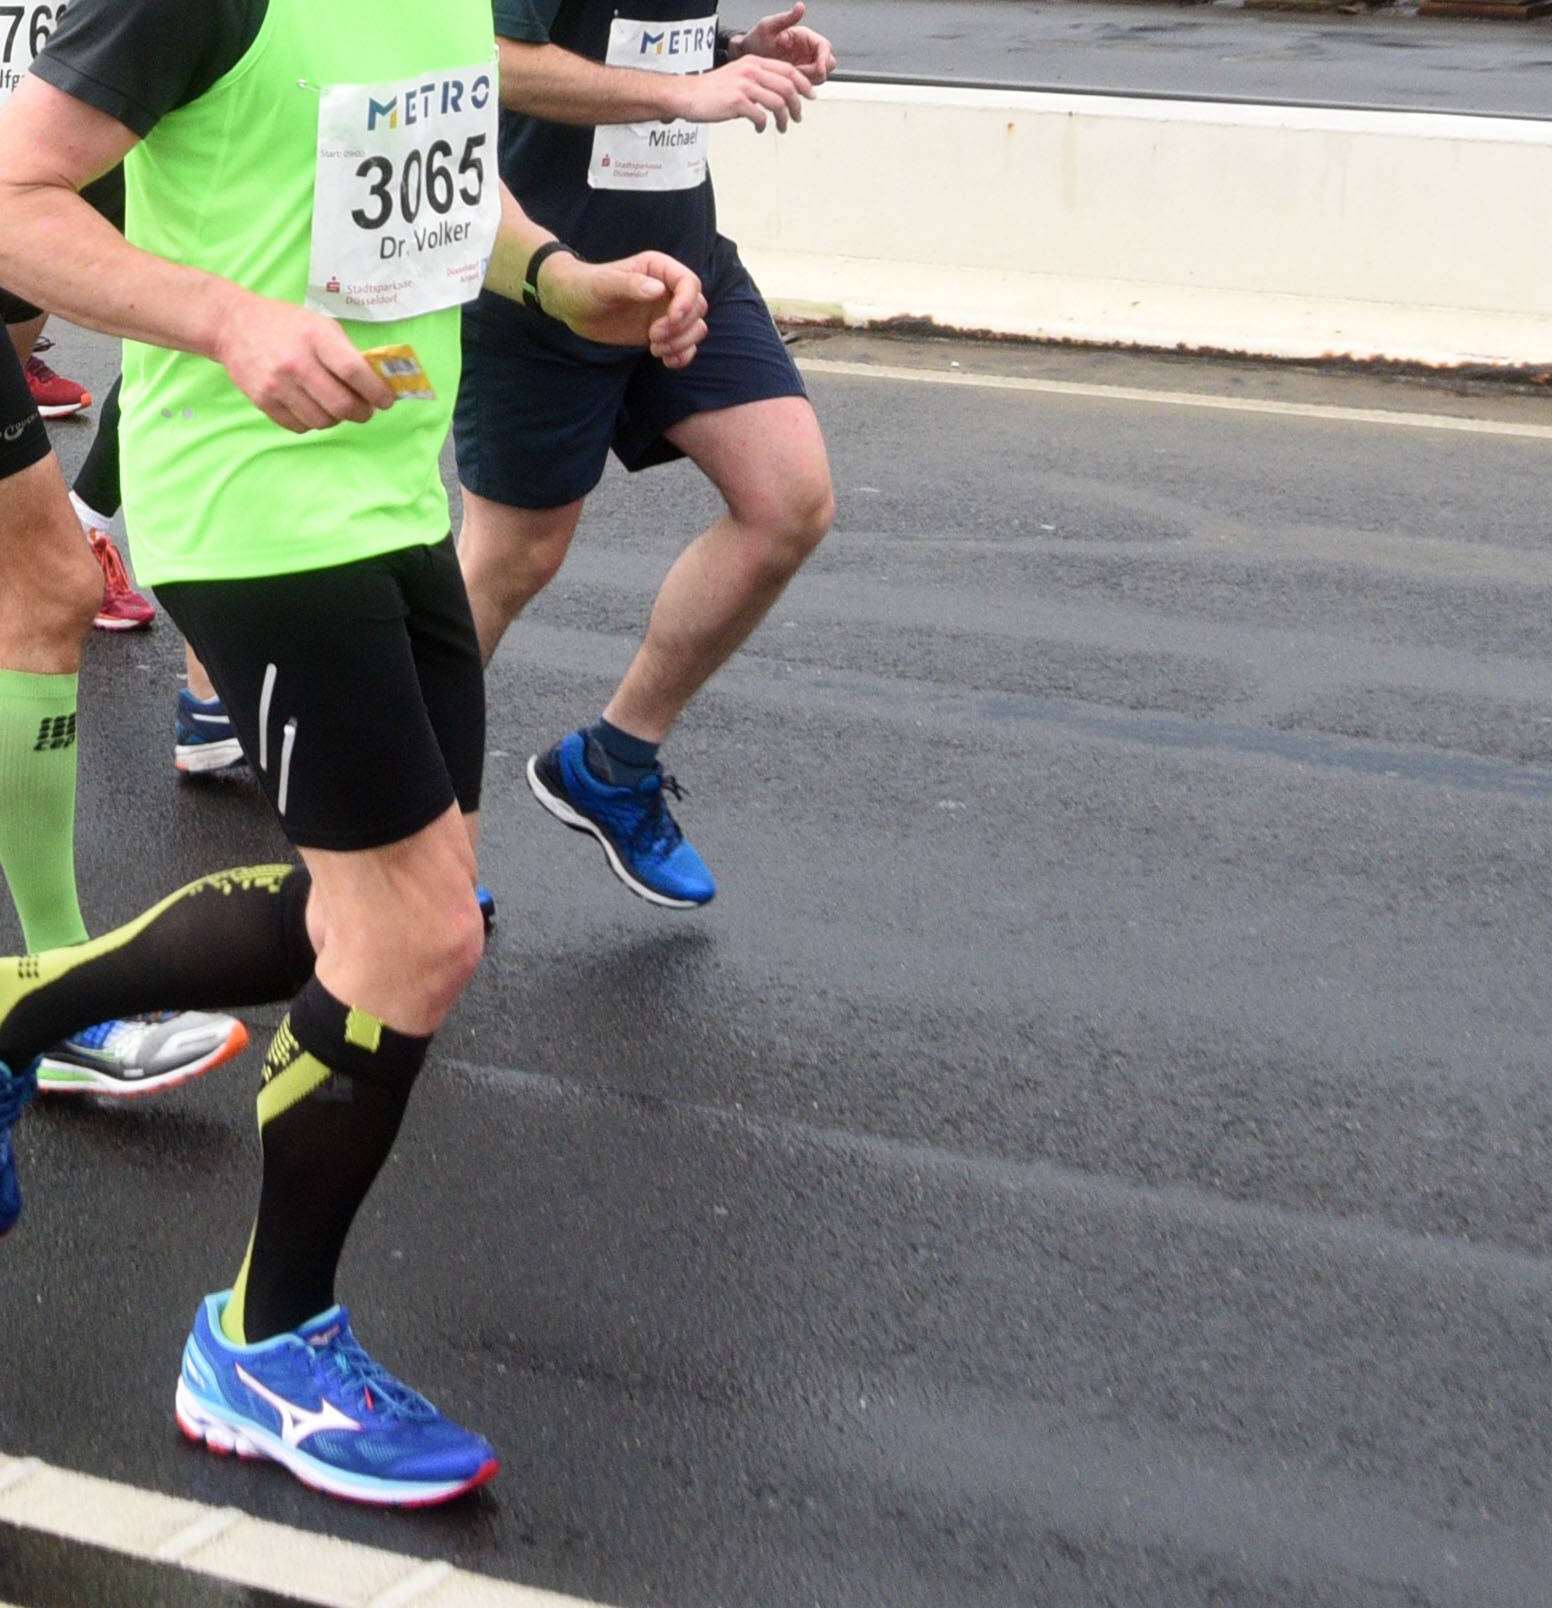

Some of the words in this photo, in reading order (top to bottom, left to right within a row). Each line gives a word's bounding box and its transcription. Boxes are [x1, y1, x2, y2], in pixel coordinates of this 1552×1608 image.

[639, 25, 714, 55] METRO
[367, 75, 490, 131] METRO
[648, 128, 698, 148] Michael
[351, 132, 487, 231] 3065
[380, 236, 410, 260] Dr.
[414, 221, 472, 252] Volker
